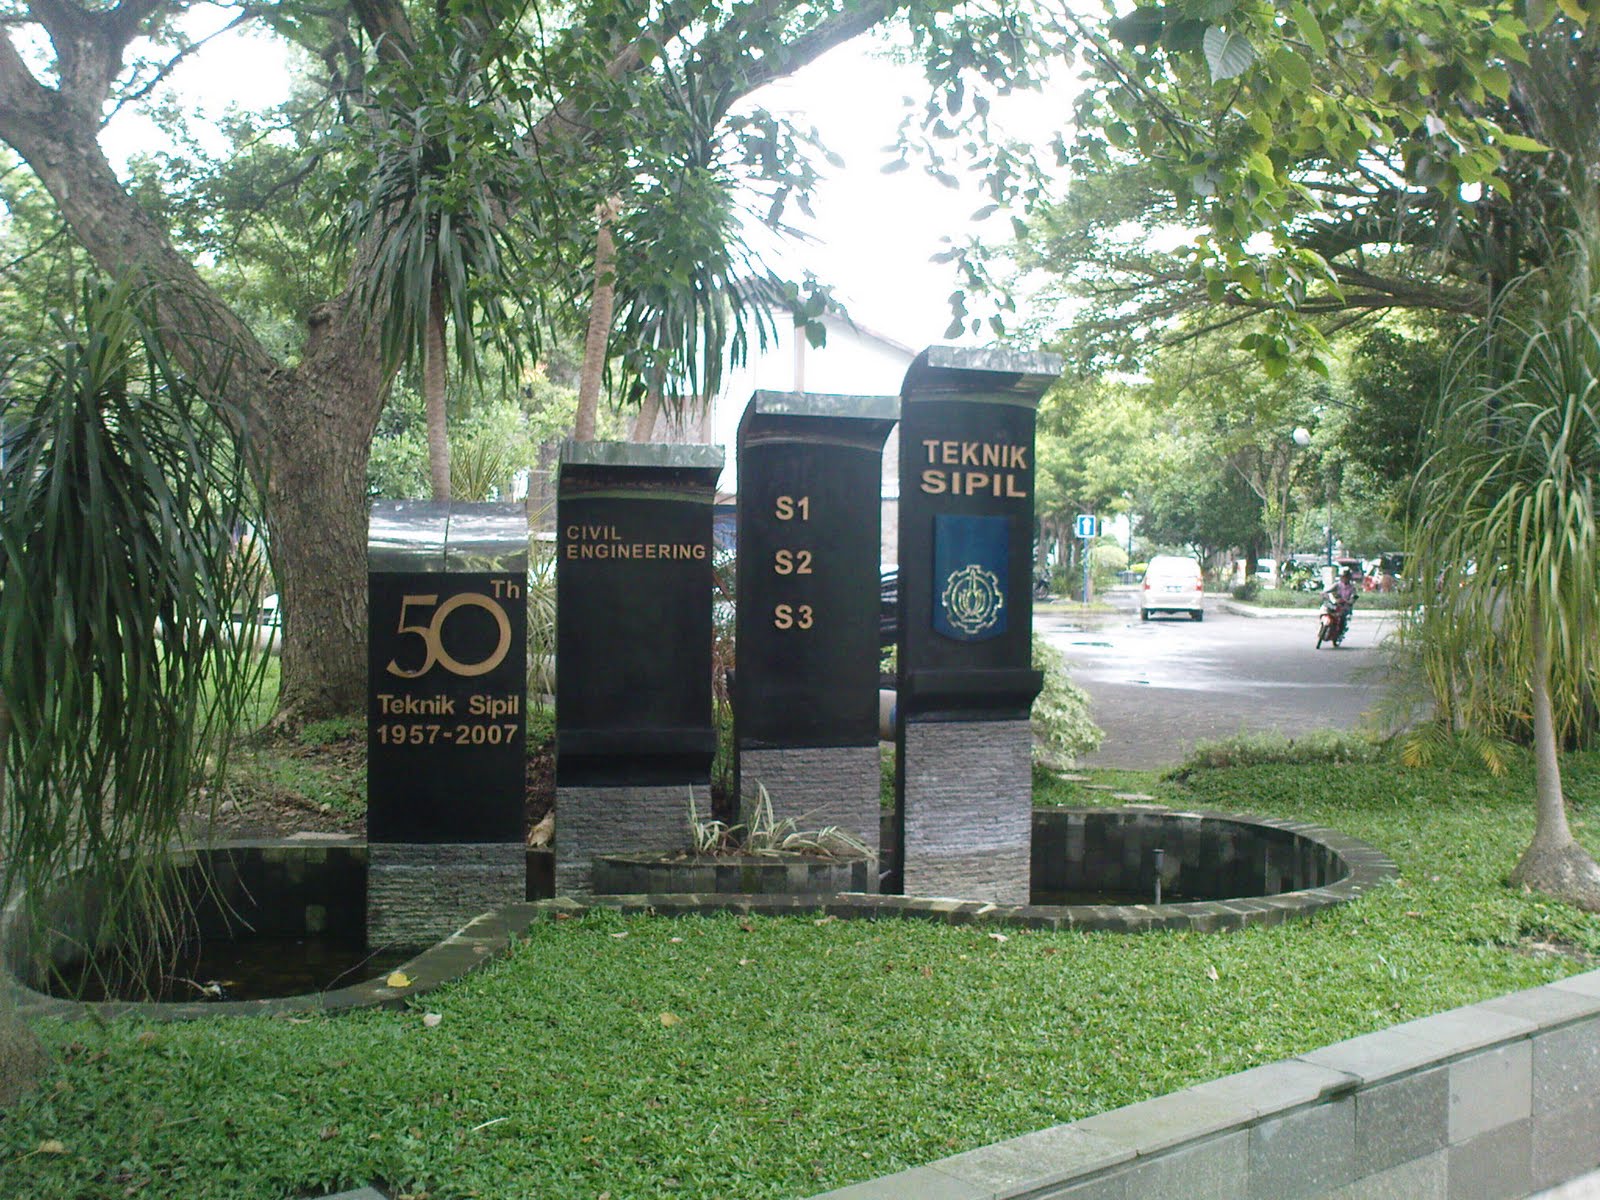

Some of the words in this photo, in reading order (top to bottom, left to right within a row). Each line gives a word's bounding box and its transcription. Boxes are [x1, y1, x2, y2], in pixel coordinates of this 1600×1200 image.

[923, 440, 1027, 470] TEKNIK
[920, 470, 1027, 498] SIPIL
[775, 496, 809, 521] S1
[567, 525, 622, 540] CIVIL
[567, 544, 706, 559] ENGINEERING
[774, 549, 813, 575] S2
[774, 604, 814, 630] S3
[377, 694, 455, 715] Teknik
[469, 695, 519, 719] Sipil
[377, 725, 518, 745] 1957-2007
